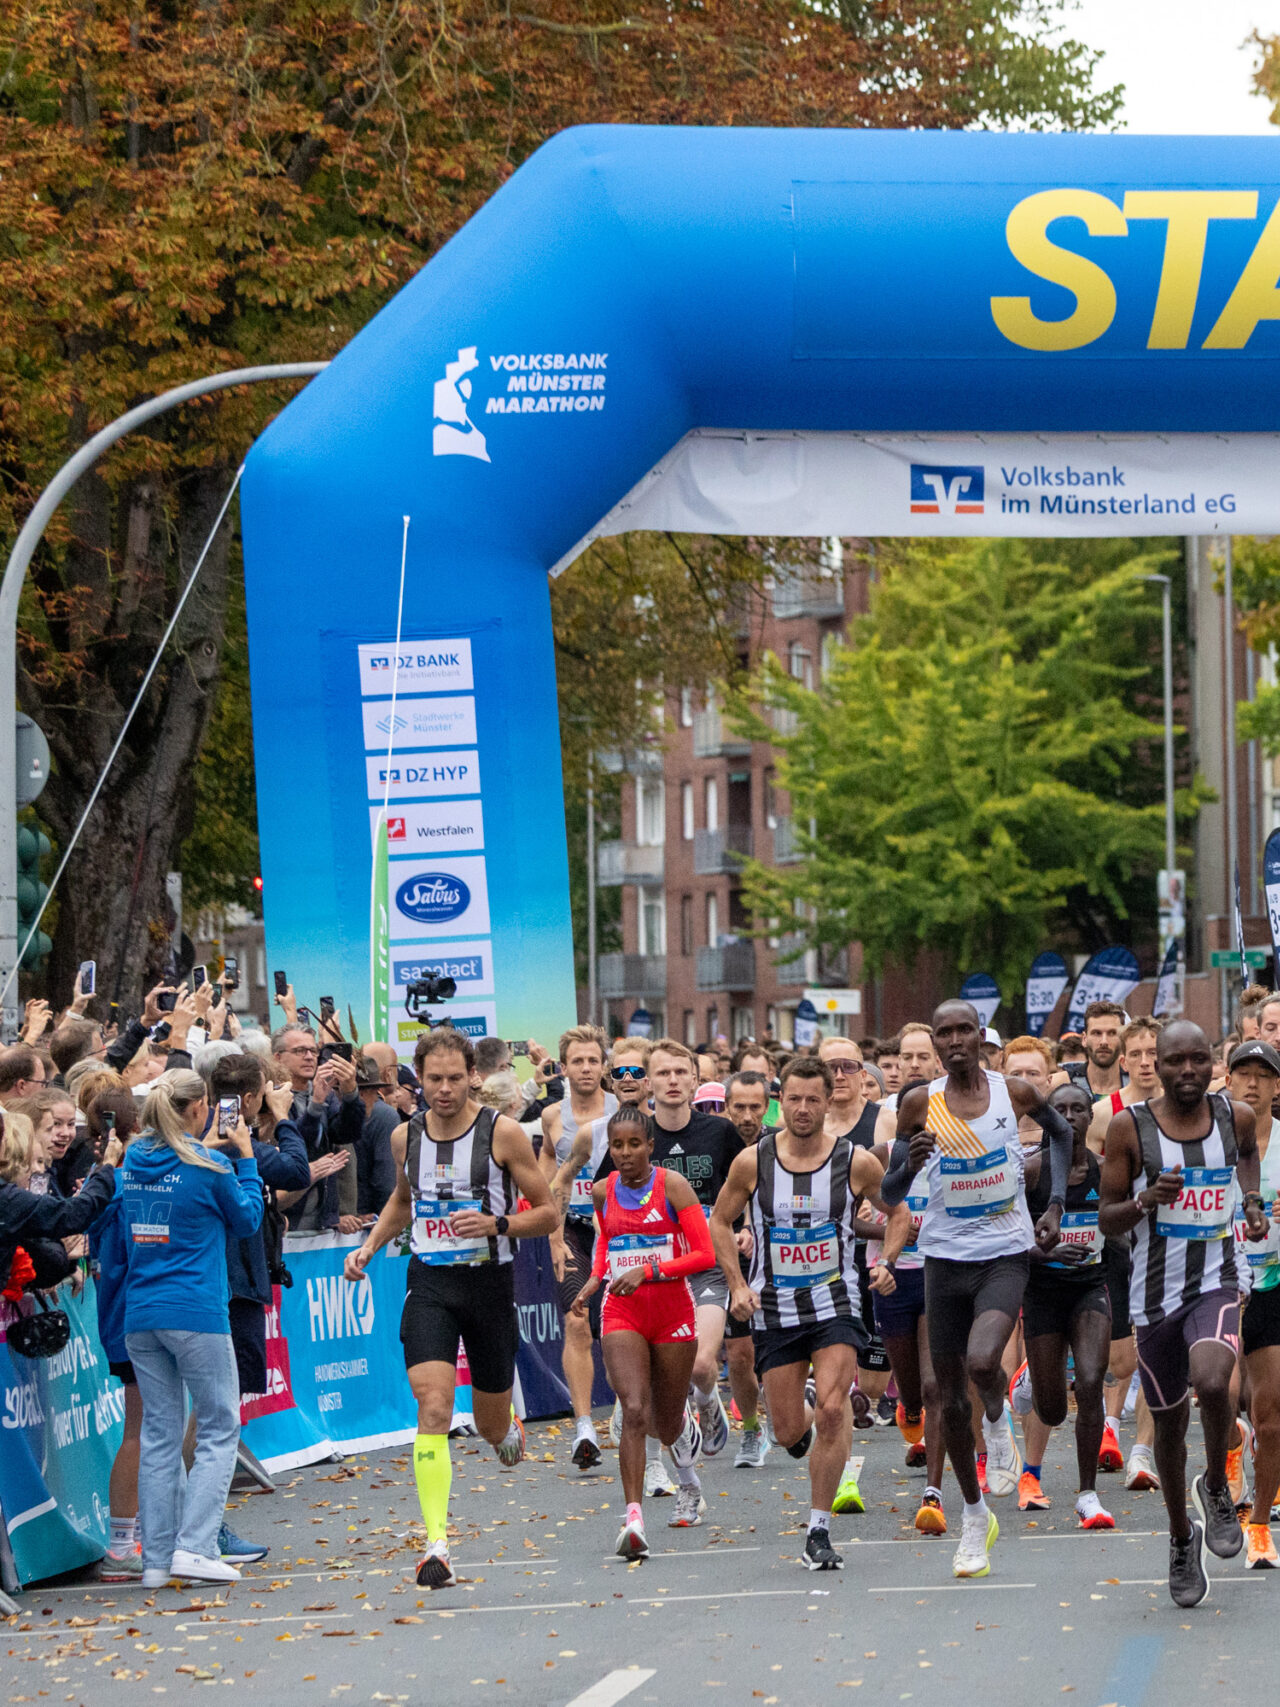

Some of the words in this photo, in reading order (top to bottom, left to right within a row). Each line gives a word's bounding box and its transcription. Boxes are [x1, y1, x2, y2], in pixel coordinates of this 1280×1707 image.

[490, 353, 608, 371] VOLKSBANK
[507, 372, 606, 392] MÜNSTER
[485, 396, 606, 414] MARATHON
[1001, 466, 1126, 487] Volksbank
[1001, 493, 1030, 513] im
[1040, 493, 1196, 514] Münsterland
[1205, 494, 1236, 513] eG
[393, 656, 413, 669] DZ
[417, 653, 460, 668] BANK
[412, 713, 465, 723] Stadtwerke
[412, 723, 453, 733] Münster
[406, 769, 429, 783] DZ
[433, 765, 468, 781] HYP
[417, 824, 474, 838] Westfalen
[404, 879, 461, 906] Salvus
[575, 1181, 594, 1196] 19
[951, 1172, 1005, 1191] ABRAHAM
[617, 1254, 662, 1267] ABERASH
[780, 1242, 831, 1264] PACE
[307, 1276, 362, 1342] HWK
